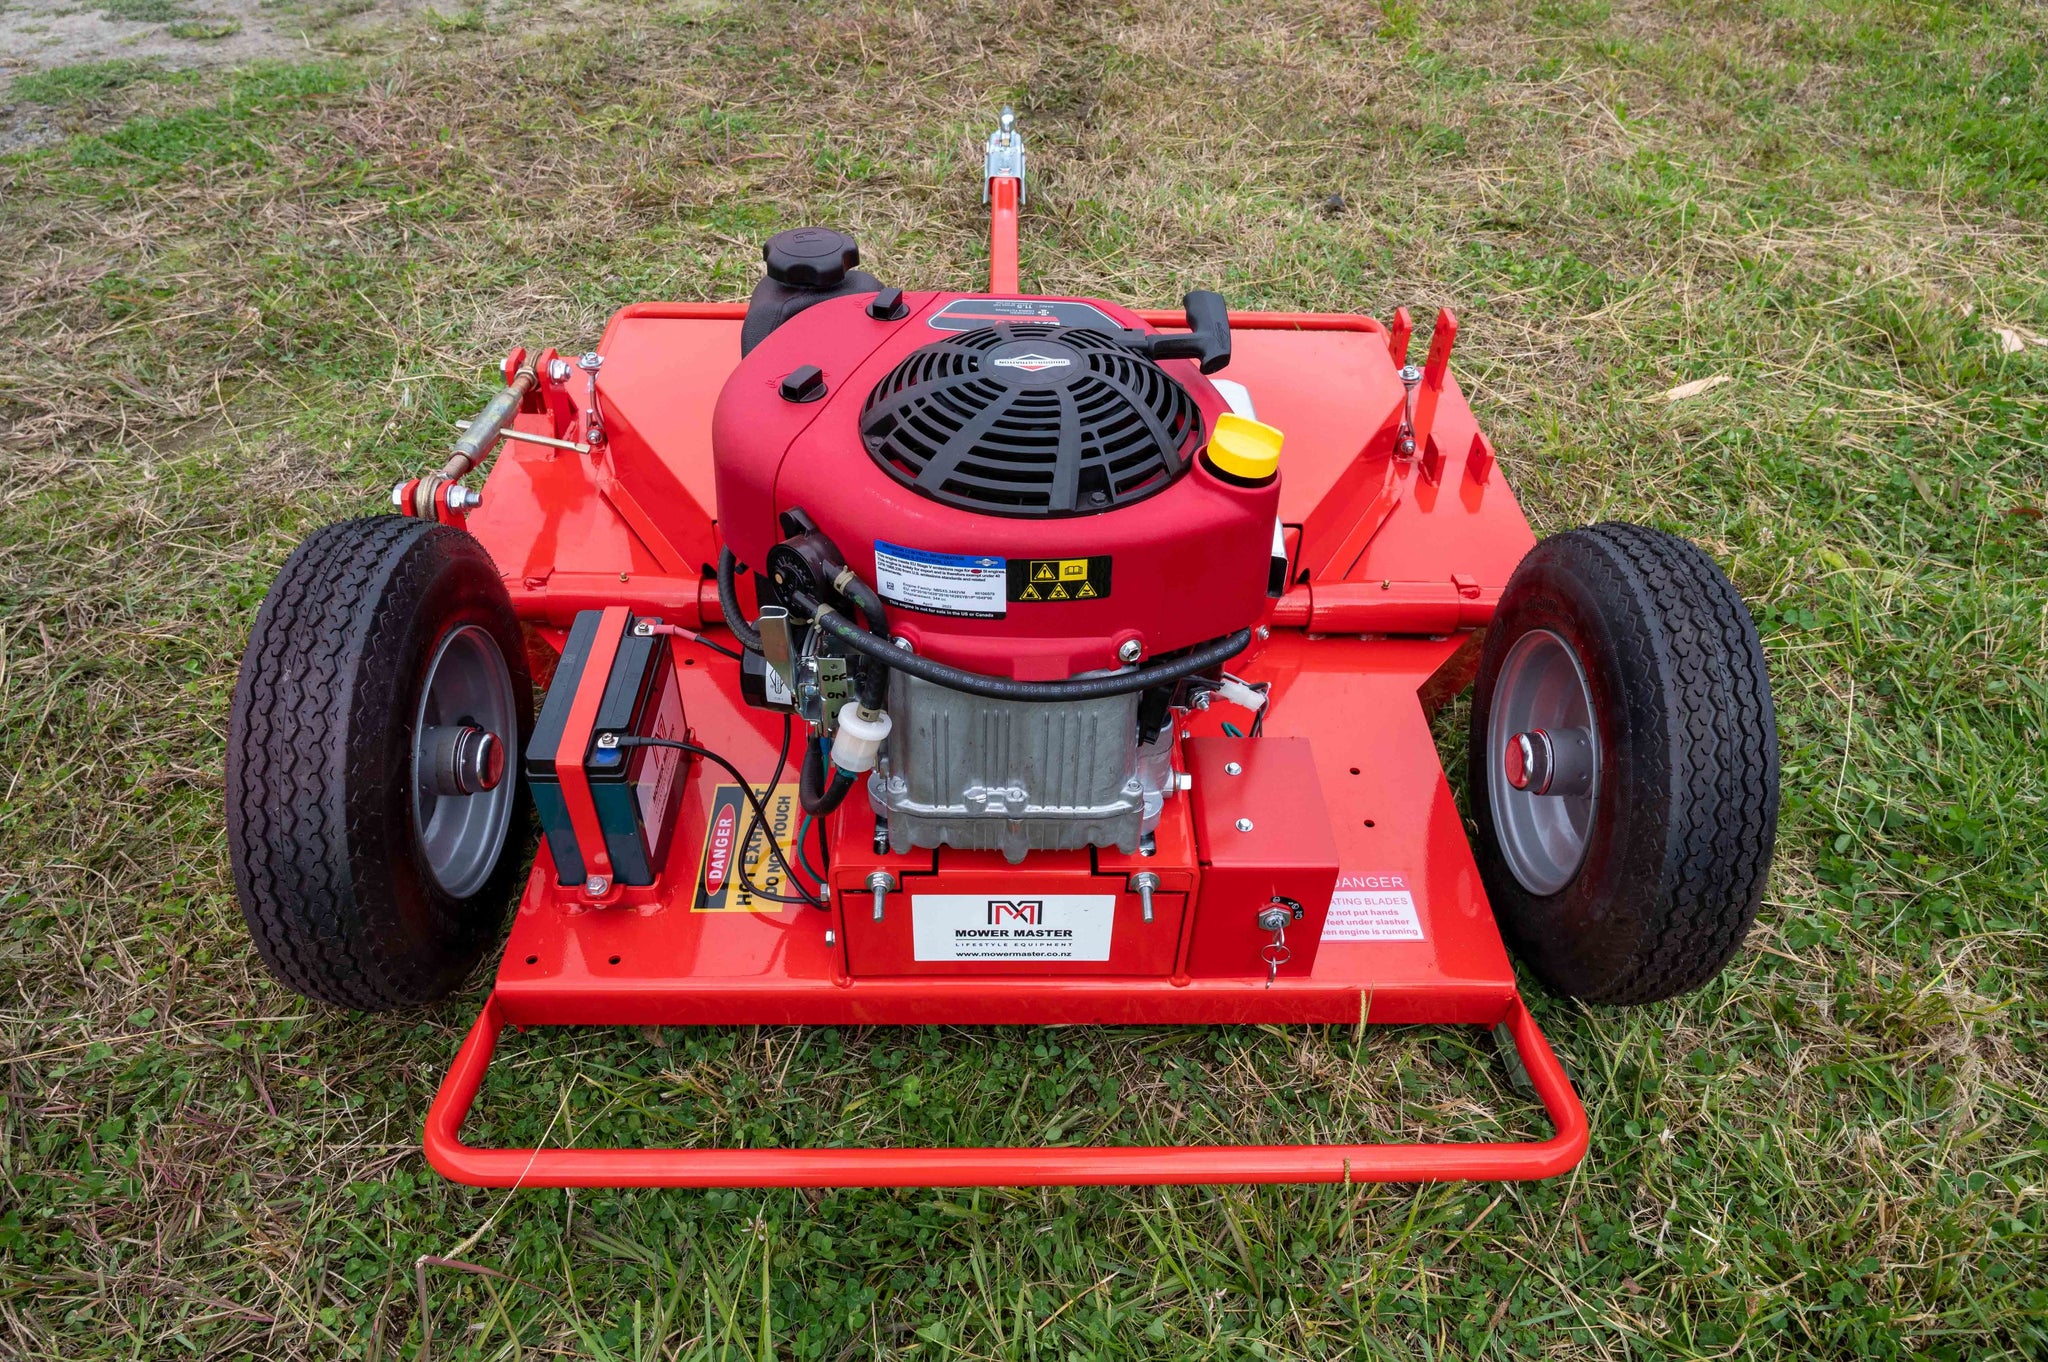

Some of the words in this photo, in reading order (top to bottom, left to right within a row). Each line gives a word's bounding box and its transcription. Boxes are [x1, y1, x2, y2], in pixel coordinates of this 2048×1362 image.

[822, 673, 846, 682] OFF
[709, 818, 732, 879] DANGER
[765, 876, 779, 895] DO
[774, 796, 791, 838] TOUCH
[1364, 897, 1408, 905] BLADES
[955, 929, 1009, 937] MOWER
[1014, 929, 1073, 937] MASTER
[1382, 928, 1418, 936] running
